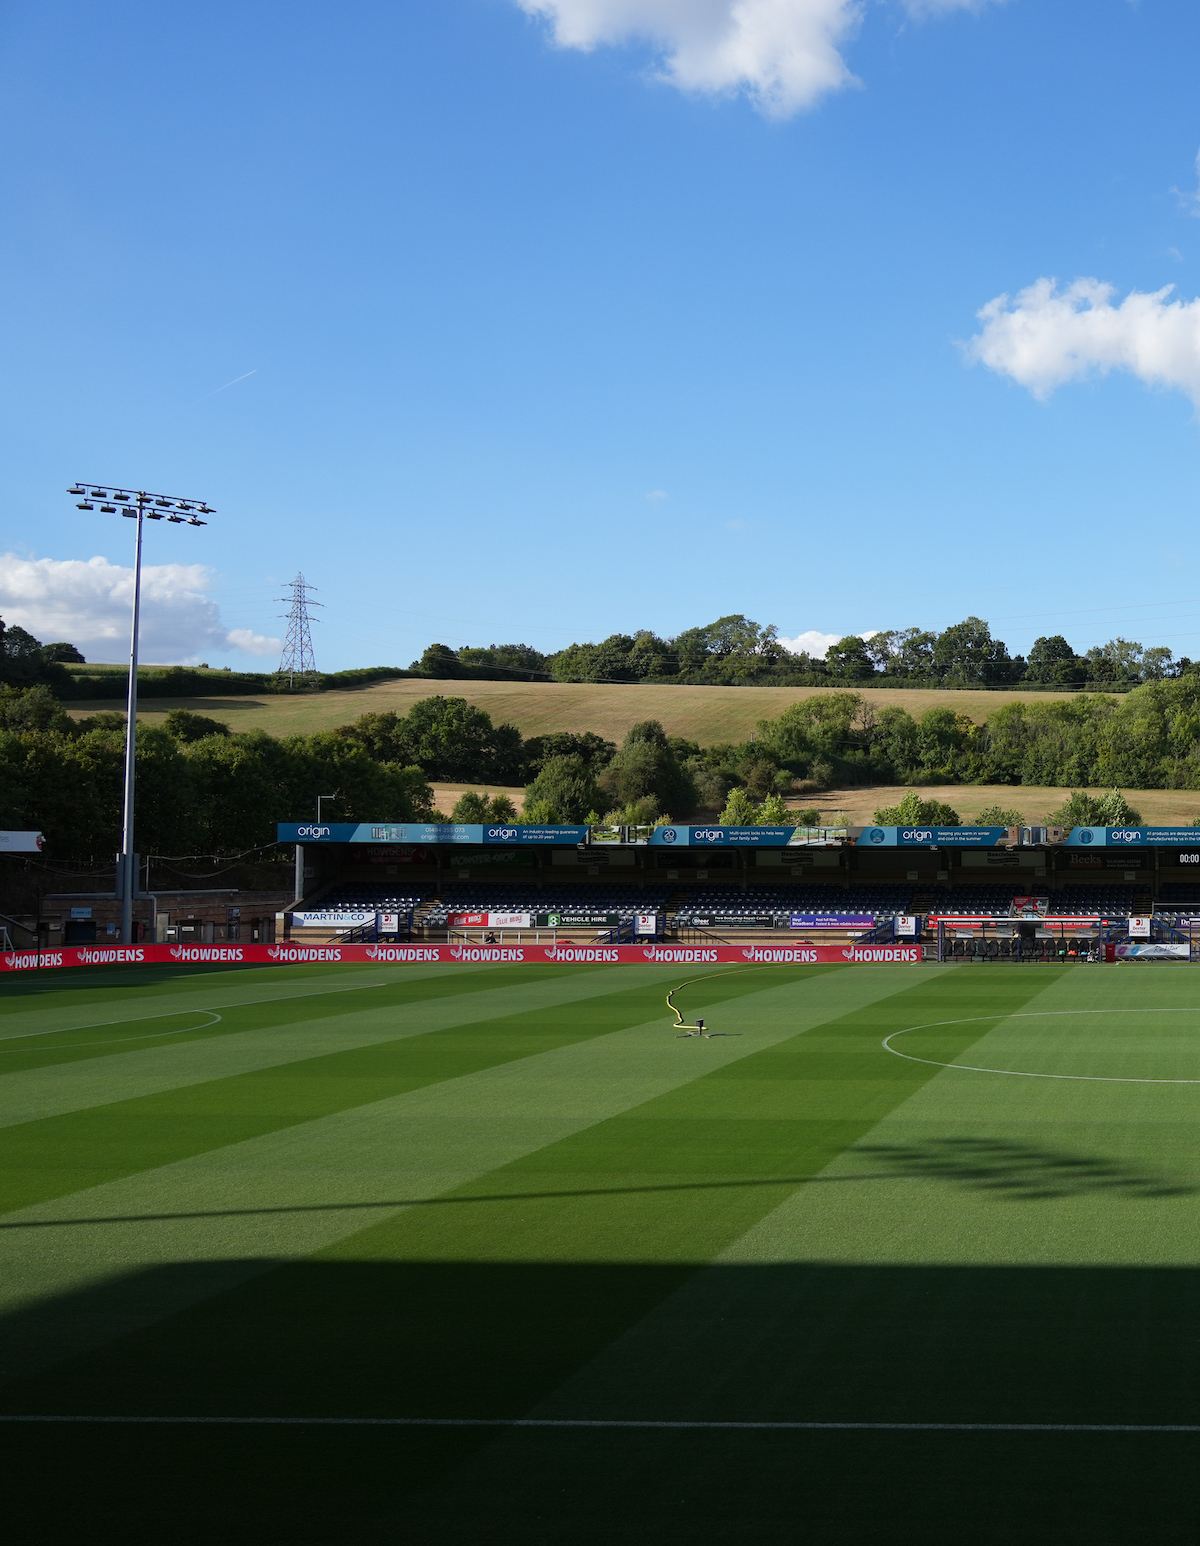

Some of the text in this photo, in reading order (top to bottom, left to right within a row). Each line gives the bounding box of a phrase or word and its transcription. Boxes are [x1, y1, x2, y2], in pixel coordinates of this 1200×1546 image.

[298, 825, 330, 839] origin
[488, 827, 517, 840] origin
[694, 829, 724, 842] origin
[902, 829, 932, 842] origin
[1111, 829, 1141, 842] origin
[1070, 854, 1102, 864] Beeks
[1180, 854, 1200, 863] 00:00
[303, 913, 365, 921] MARTIN&CO
[14, 952, 63, 969] HOWDENS
[85, 949, 144, 963] HOWDENS
[181, 948, 243, 962] HOWDENS
[280, 948, 342, 961] HOWDENS
[378, 948, 440, 961] HOWDENS
[462, 948, 524, 961] HOWDENS
[556, 949, 619, 962] HOWDENS
[655, 949, 718, 962] HOWDENS
[754, 949, 817, 962] HOWDENS
[854, 949, 917, 962] HOWDENS
